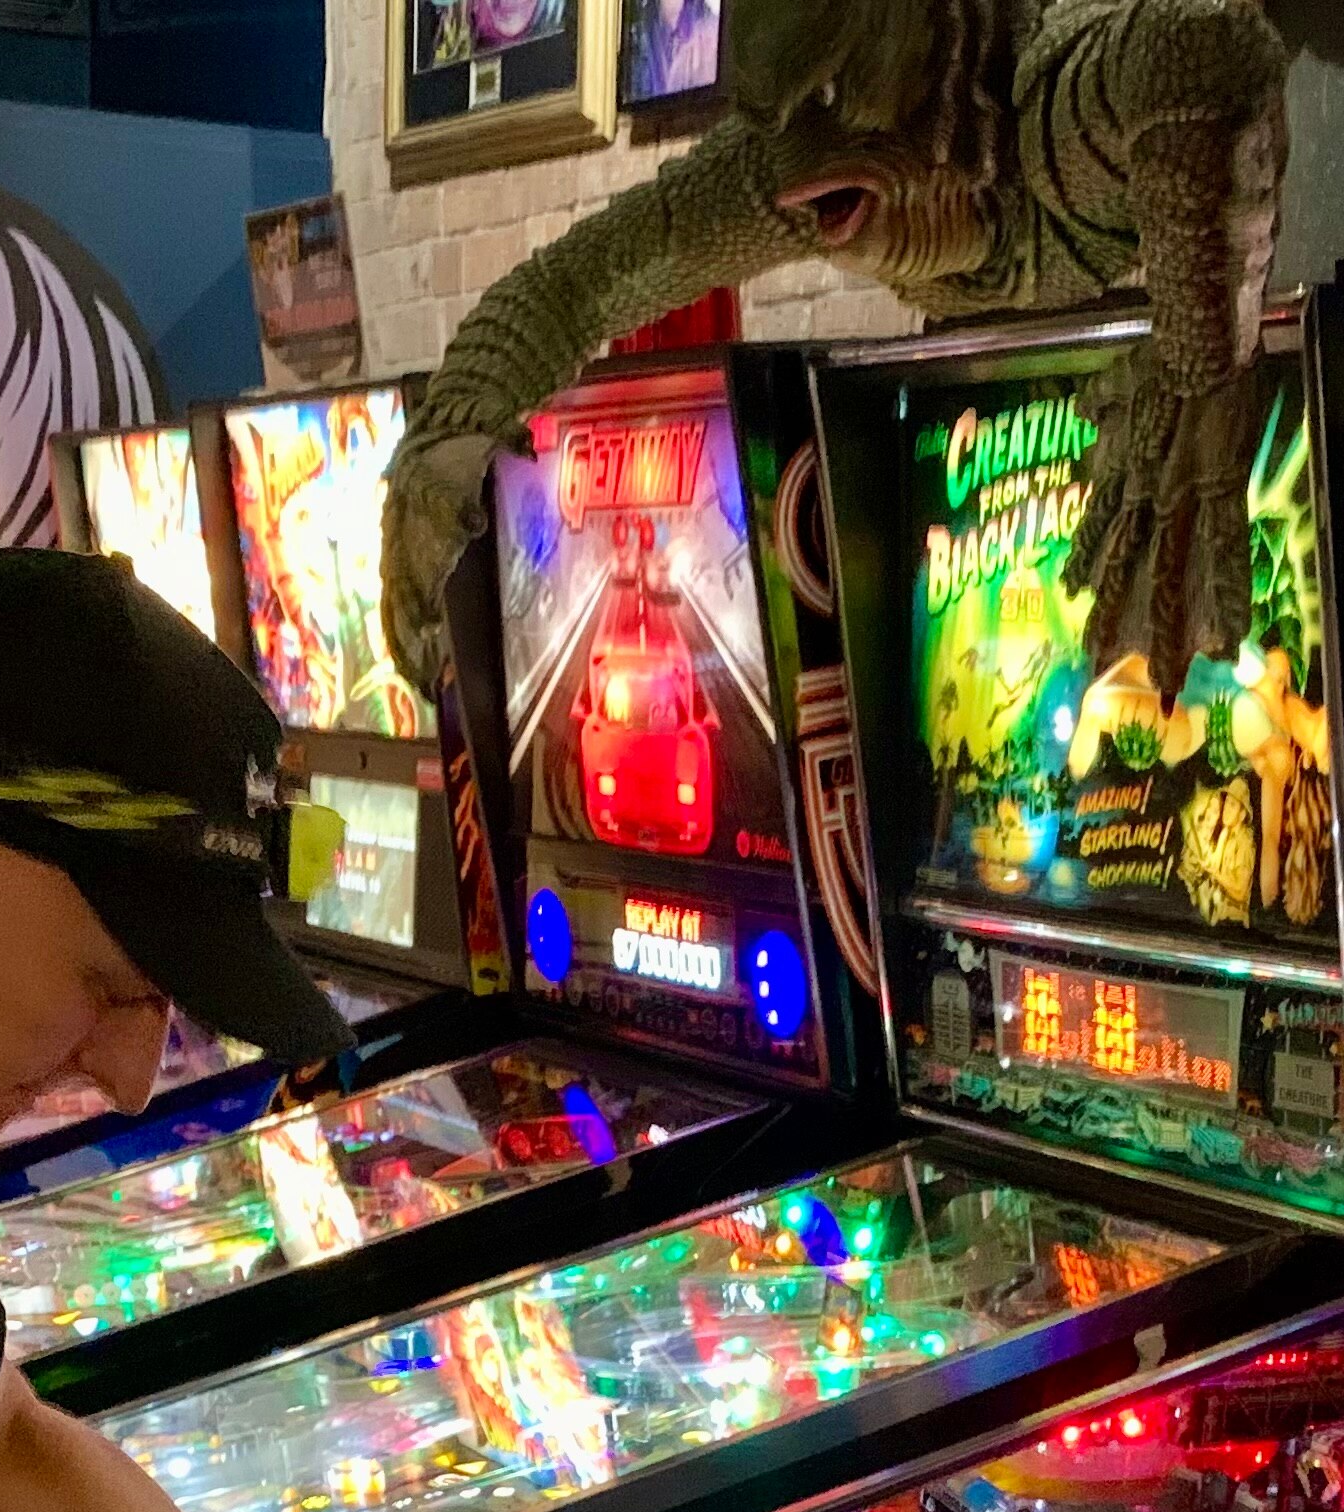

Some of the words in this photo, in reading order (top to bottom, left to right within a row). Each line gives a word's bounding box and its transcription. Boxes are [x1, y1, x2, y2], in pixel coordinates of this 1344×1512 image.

[559, 420, 706, 533] GETAWAY
[979, 470, 1030, 526] FROM
[1034, 457, 1072, 498] THE
[926, 505, 1022, 615] BLACK
[1075, 775, 1154, 817] AMAZING!
[1080, 816, 1174, 858] STARTLING!
[1087, 854, 1175, 892] SHOCKING!
[625, 898, 681, 940] REPLAY
[681, 908, 702, 943] AT
